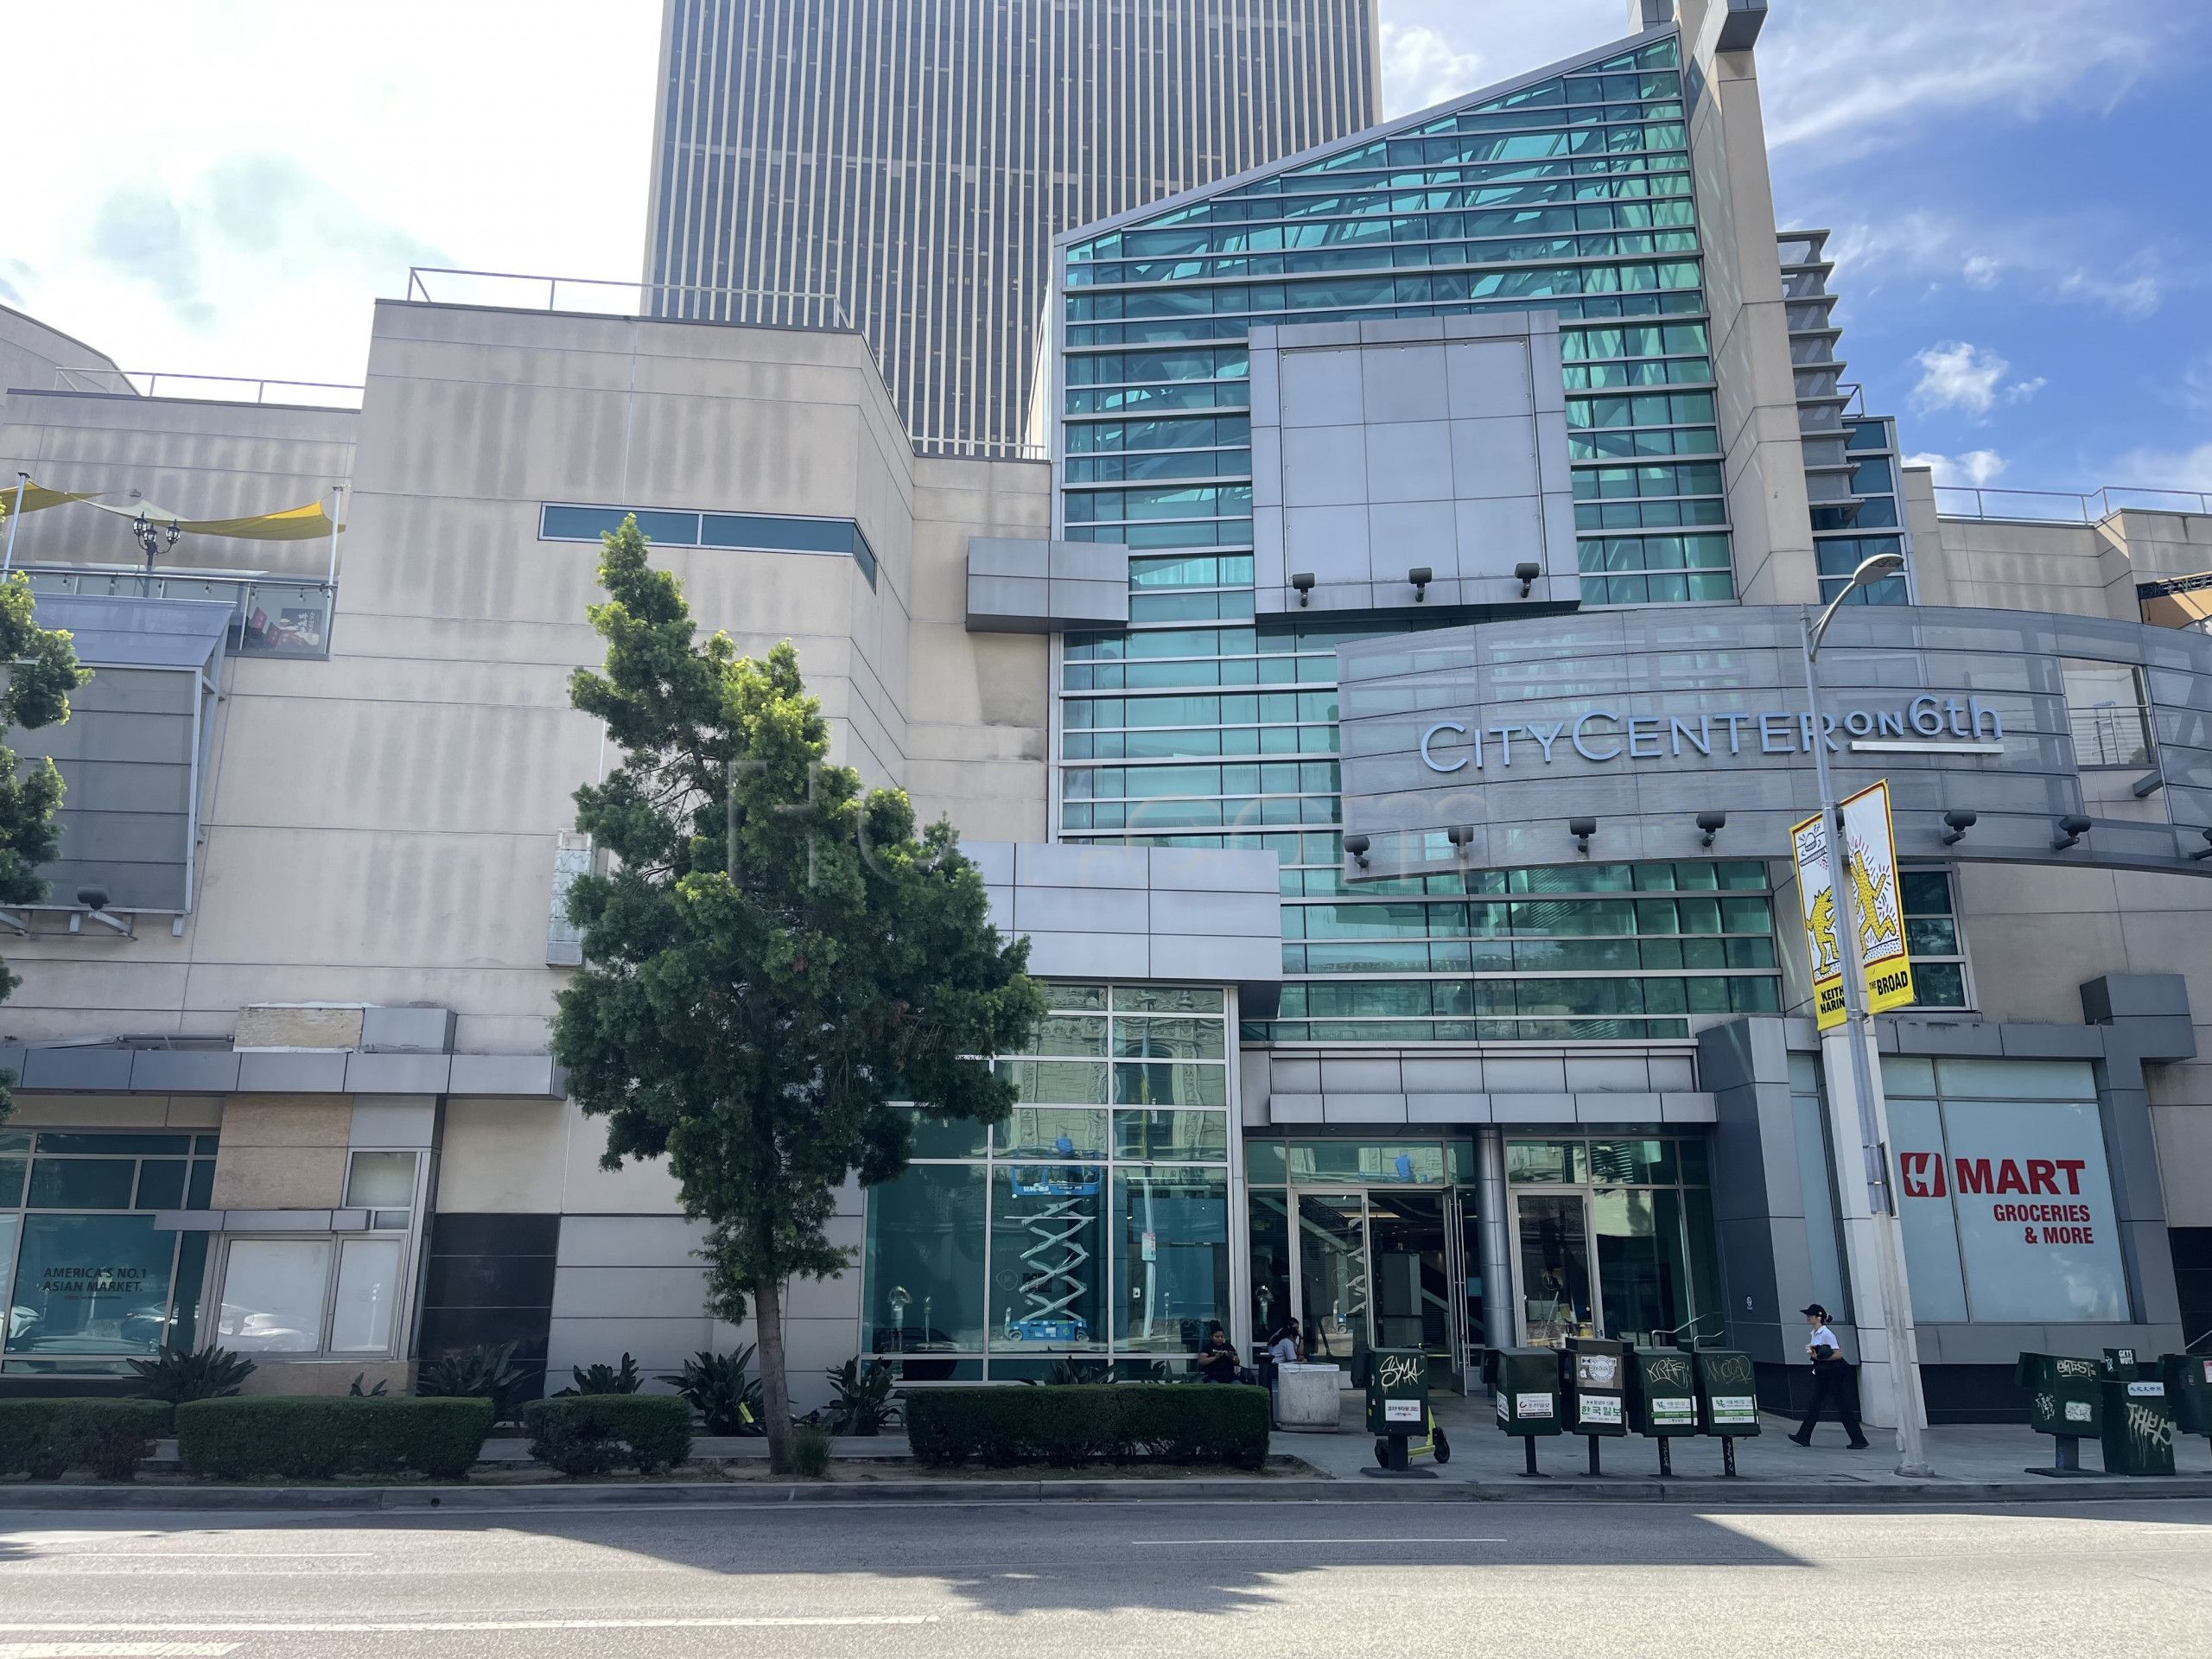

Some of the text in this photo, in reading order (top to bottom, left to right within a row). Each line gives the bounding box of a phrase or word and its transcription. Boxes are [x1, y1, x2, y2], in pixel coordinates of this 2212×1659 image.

[1843, 709, 1905, 737] ON
[1908, 694, 2004, 741] 6th
[1868, 970, 1909, 996] THE BROAD
[1821, 984, 1845, 1002] KEITH
[1955, 1159, 2086, 1195] MART
[1993, 1205, 2091, 1223] GROCERIES
[2024, 1227, 2094, 1244] & MORE
[43, 1268, 146, 1279] AMERICA'S NO.1
[43, 1281, 143, 1293] ASIAN MARKET.
[1581, 1405, 1622, 1417] 한국일보
